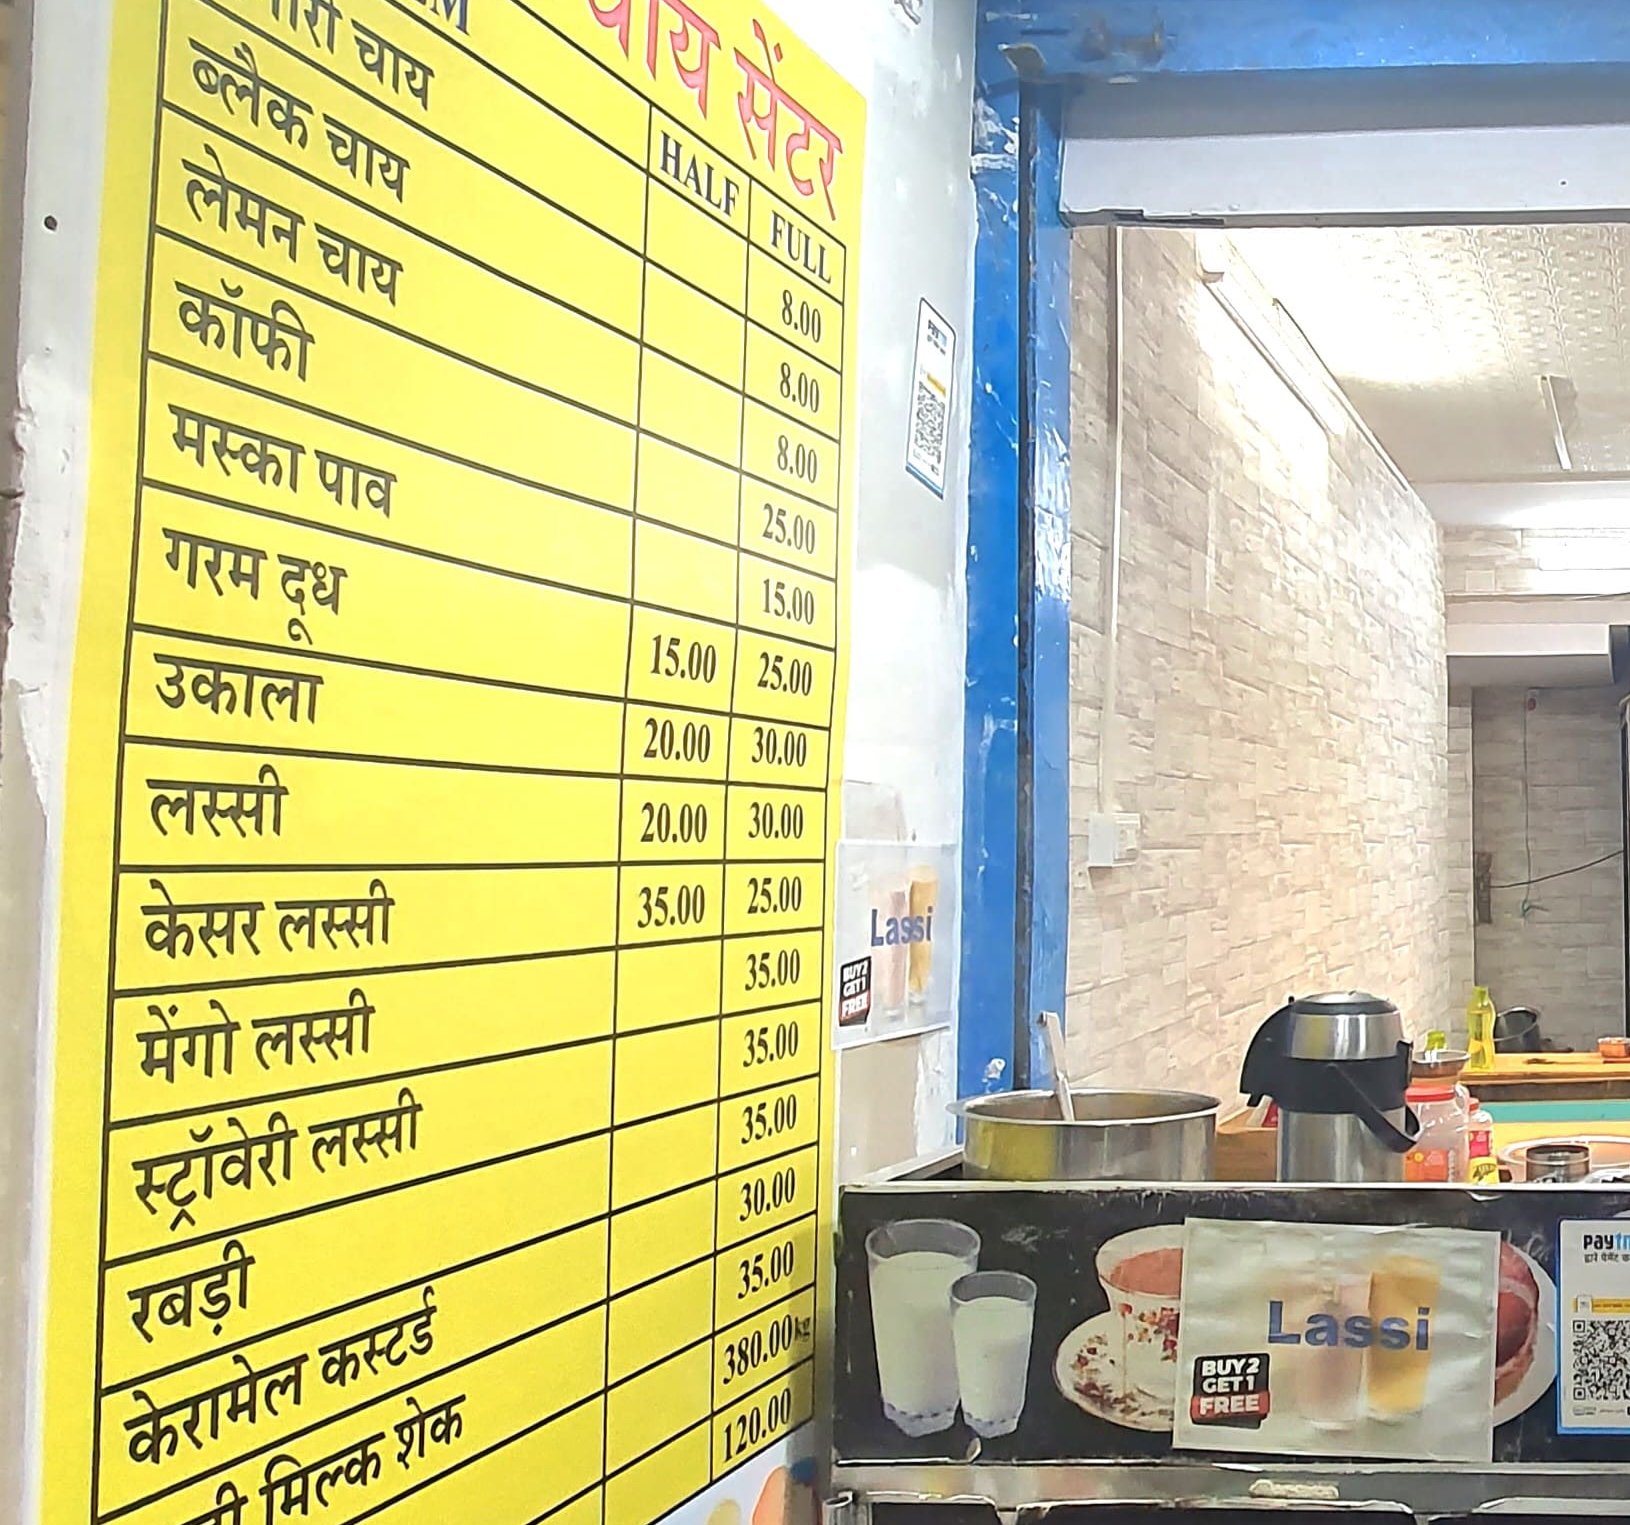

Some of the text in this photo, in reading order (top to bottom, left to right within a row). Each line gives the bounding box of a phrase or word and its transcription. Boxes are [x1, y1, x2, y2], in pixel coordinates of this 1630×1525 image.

[350, 18, 436, 111] चाय
[780, 288, 823, 345] 8.00
[733, 18, 844, 222] सेंटर
[188, 37, 821, 415] ब्लैक चाय 8.00
[659, 129, 833, 286] HALF FULL
[180, 142, 819, 486] लेमन चाय 8.00
[173, 278, 817, 556] कॉफी 25.00
[168, 403, 816, 626] मस्का पाव 15.00
[161, 527, 813, 697] गरम दूध 15.00 25.00
[153, 652, 808, 769] उकाला 20.00 30.00
[145, 763, 805, 844] लस्सी 20.00 30.00
[140, 875, 803, 960] केसर लस्सी 35.00 25.00
[870, 905, 933, 947] Lassi
[135, 947, 801, 1084] मेंगो लस्सी 35.00
[307, 1086, 424, 1174] लस्सी
[742, 1020, 799, 1069] 35.00
[127, 1093, 798, 1345] रबड़ी 35.00
[123, 1166, 796, 1465] केरामेल कस्टर्ड 30.00
[394, 1393, 468, 1471] शेक
[736, 1240, 795, 1300] 35.00
[1267, 1300, 1431, 1351] Lassi
[722, 1386, 792, 1464] 120.00
[1199, 1394, 1261, 1416] FREE
